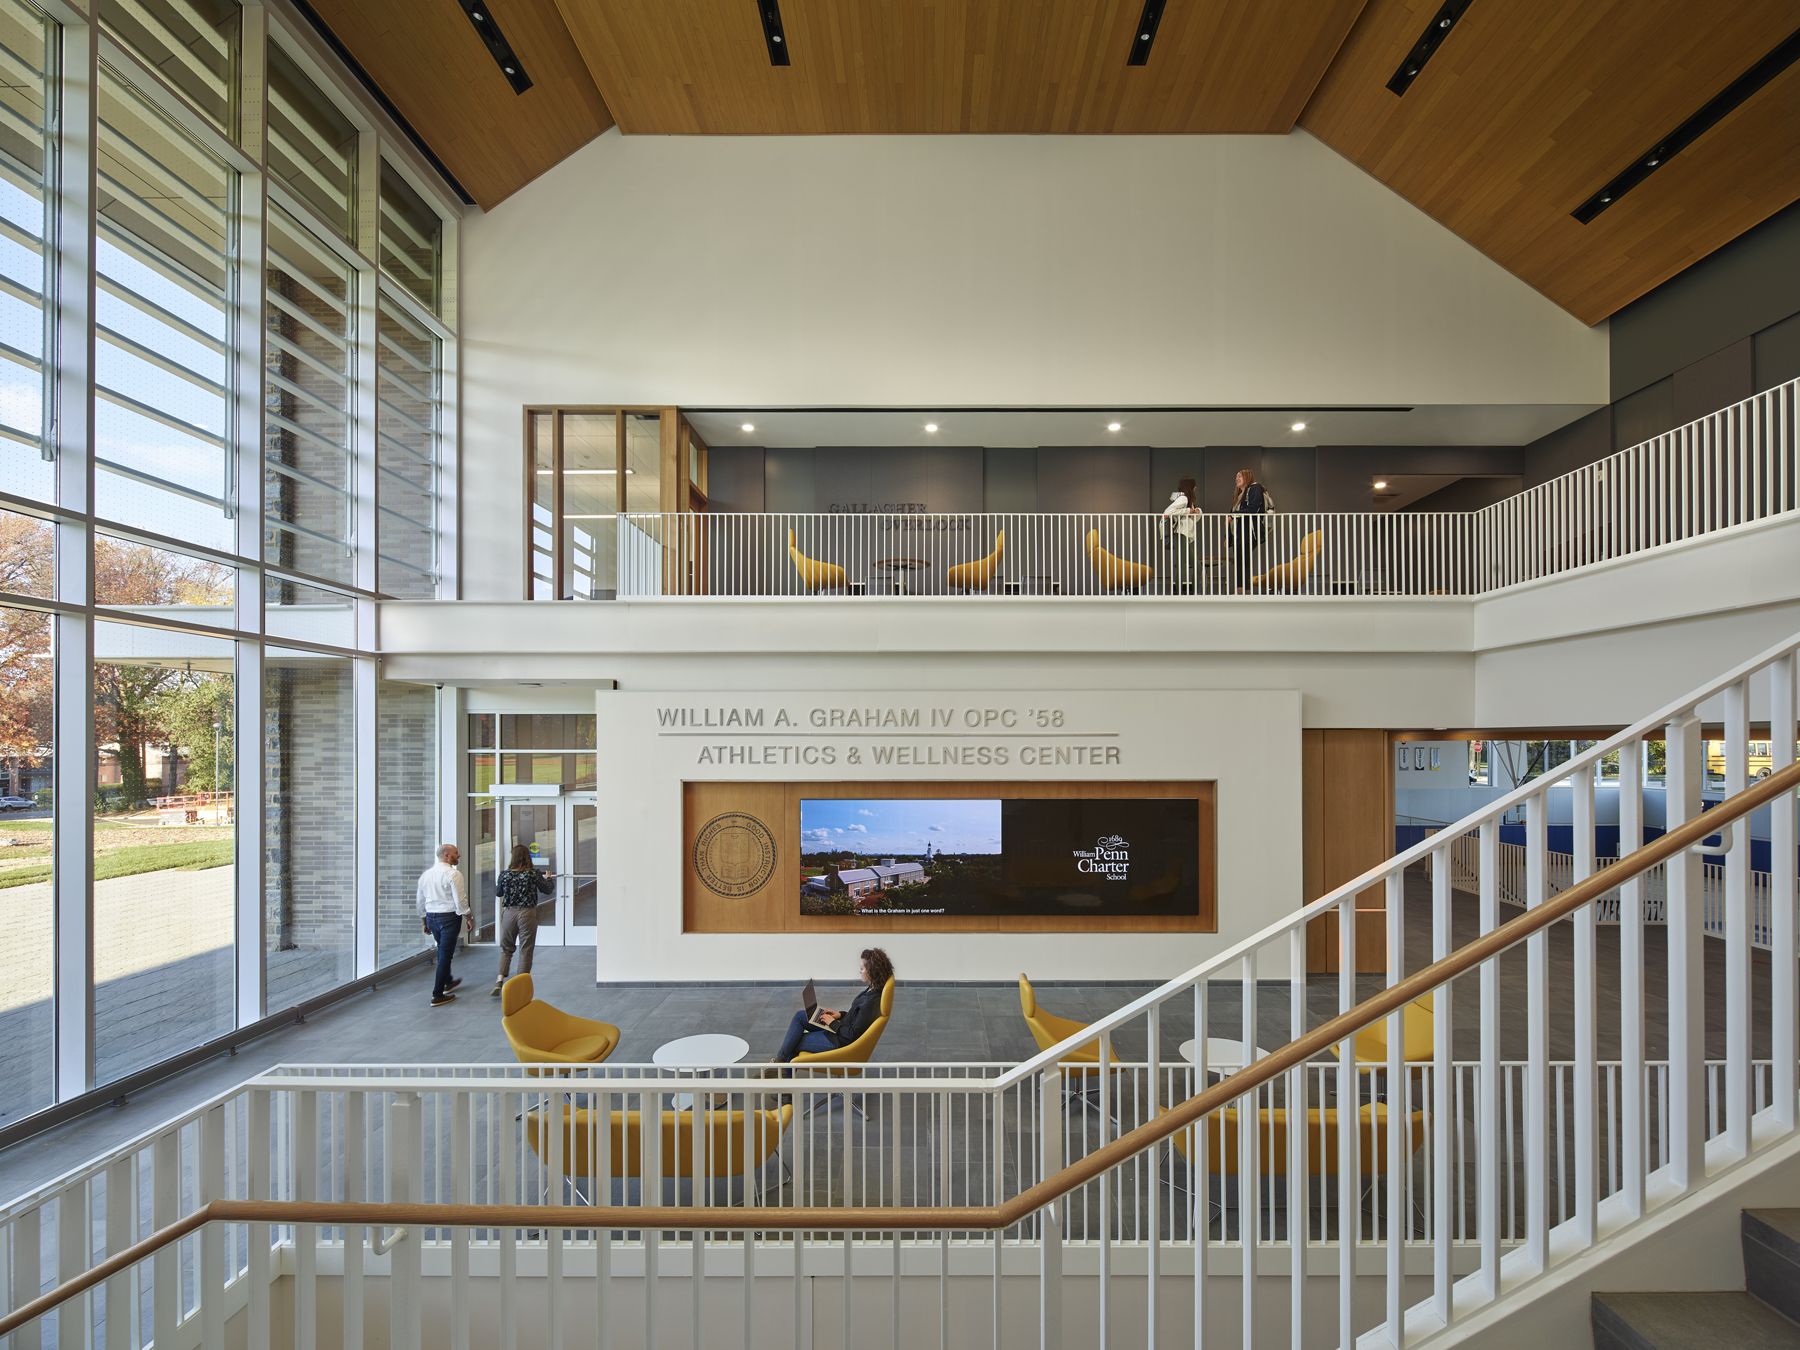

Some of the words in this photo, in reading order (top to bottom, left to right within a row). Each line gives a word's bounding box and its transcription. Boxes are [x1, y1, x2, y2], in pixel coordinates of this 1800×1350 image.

[828, 503, 928, 514] GALLAGHER
[882, 518, 972, 531] OVERLOOK
[657, 708, 764, 727] WILLIAM
[774, 708, 798, 727] A.
[809, 708, 919, 727] GRAHAM
[930, 708, 954, 727] IV
[964, 708, 1017, 727] OPC
[697, 745, 836, 765] ATHLETICS
[847, 746, 862, 765] &
[872, 746, 1009, 765] WELLNESS
[1019, 746, 1121, 765] CENTER
[701, 823, 722, 847] RICHES
[746, 822, 764, 839] GOOD
[699, 851, 707, 871] THAN
[1072, 850, 1095, 858] William
[1094, 846, 1129, 860] Penn
[748, 842, 771, 889] INSTRUCTION
[1077, 858, 1130, 873] Charter
[706, 874, 732, 892] BETTER
